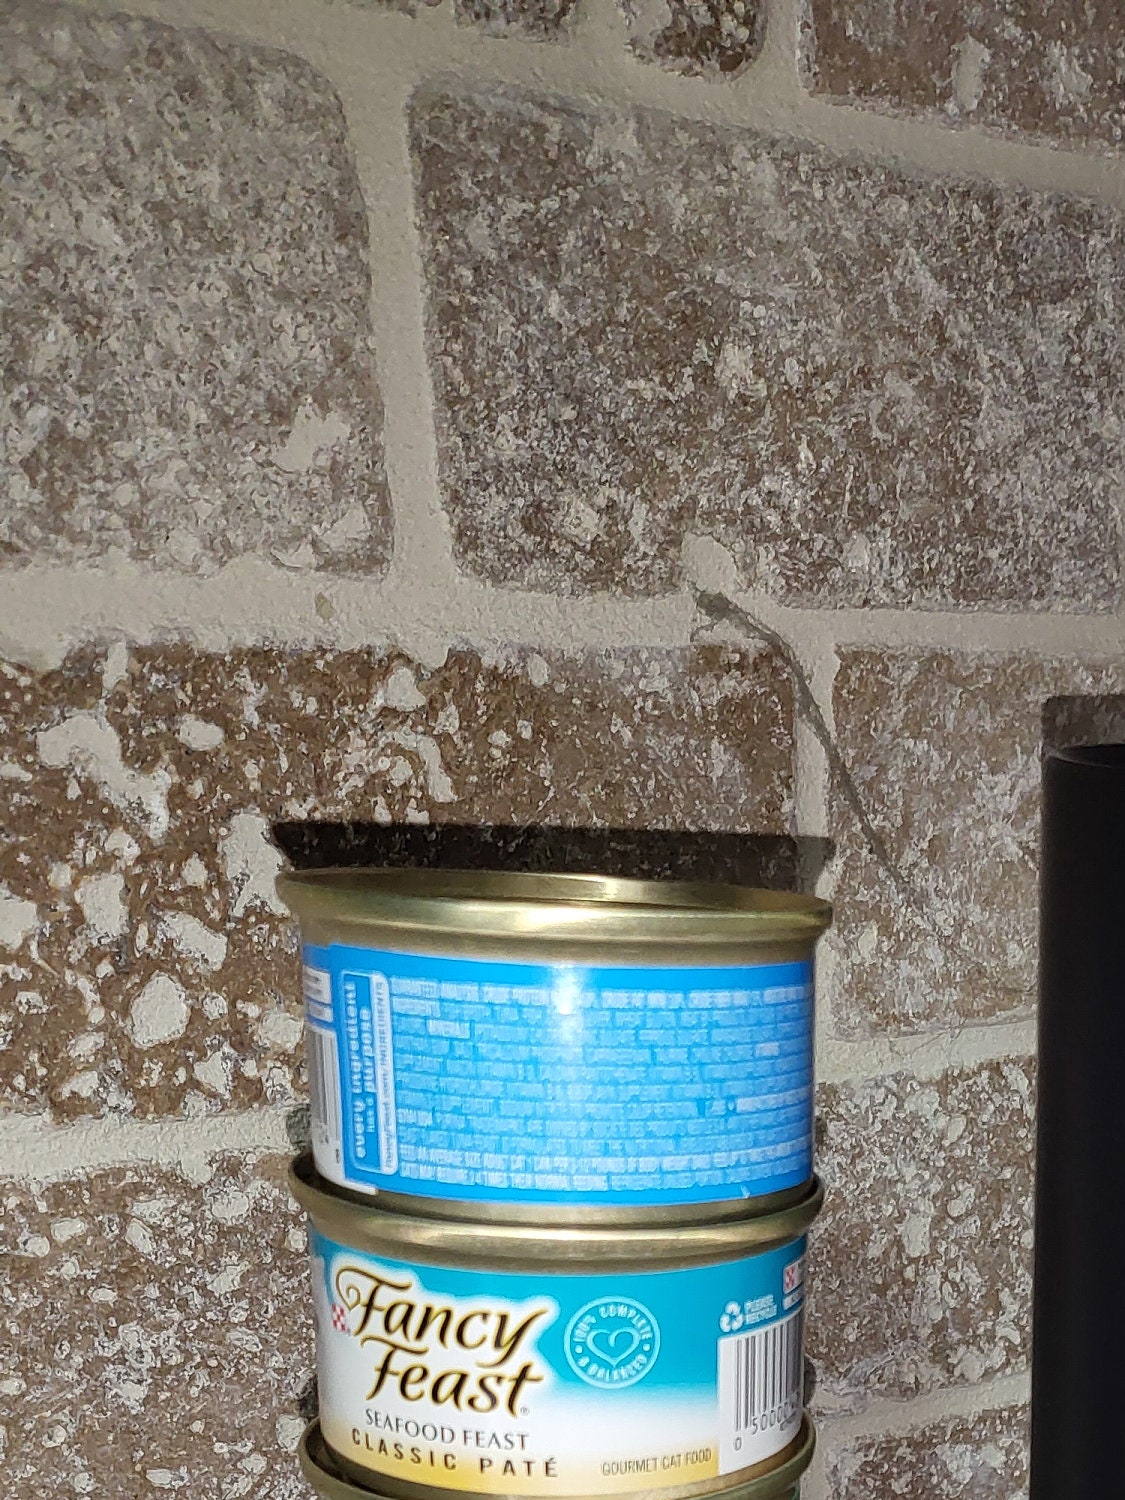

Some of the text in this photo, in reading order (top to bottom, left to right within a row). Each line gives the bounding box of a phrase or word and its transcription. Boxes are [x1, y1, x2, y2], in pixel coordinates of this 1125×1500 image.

[335, 1265, 549, 1369] Fancy
[599, 1305, 653, 1341] COMPLETE
[360, 1334, 544, 1418] Feast
[365, 1408, 530, 1451] SEAFOOD FEAST
[352, 1428, 559, 1478] CLASSIC PATÉ
[602, 1448, 712, 1476] GOURMET CAT FOOD
